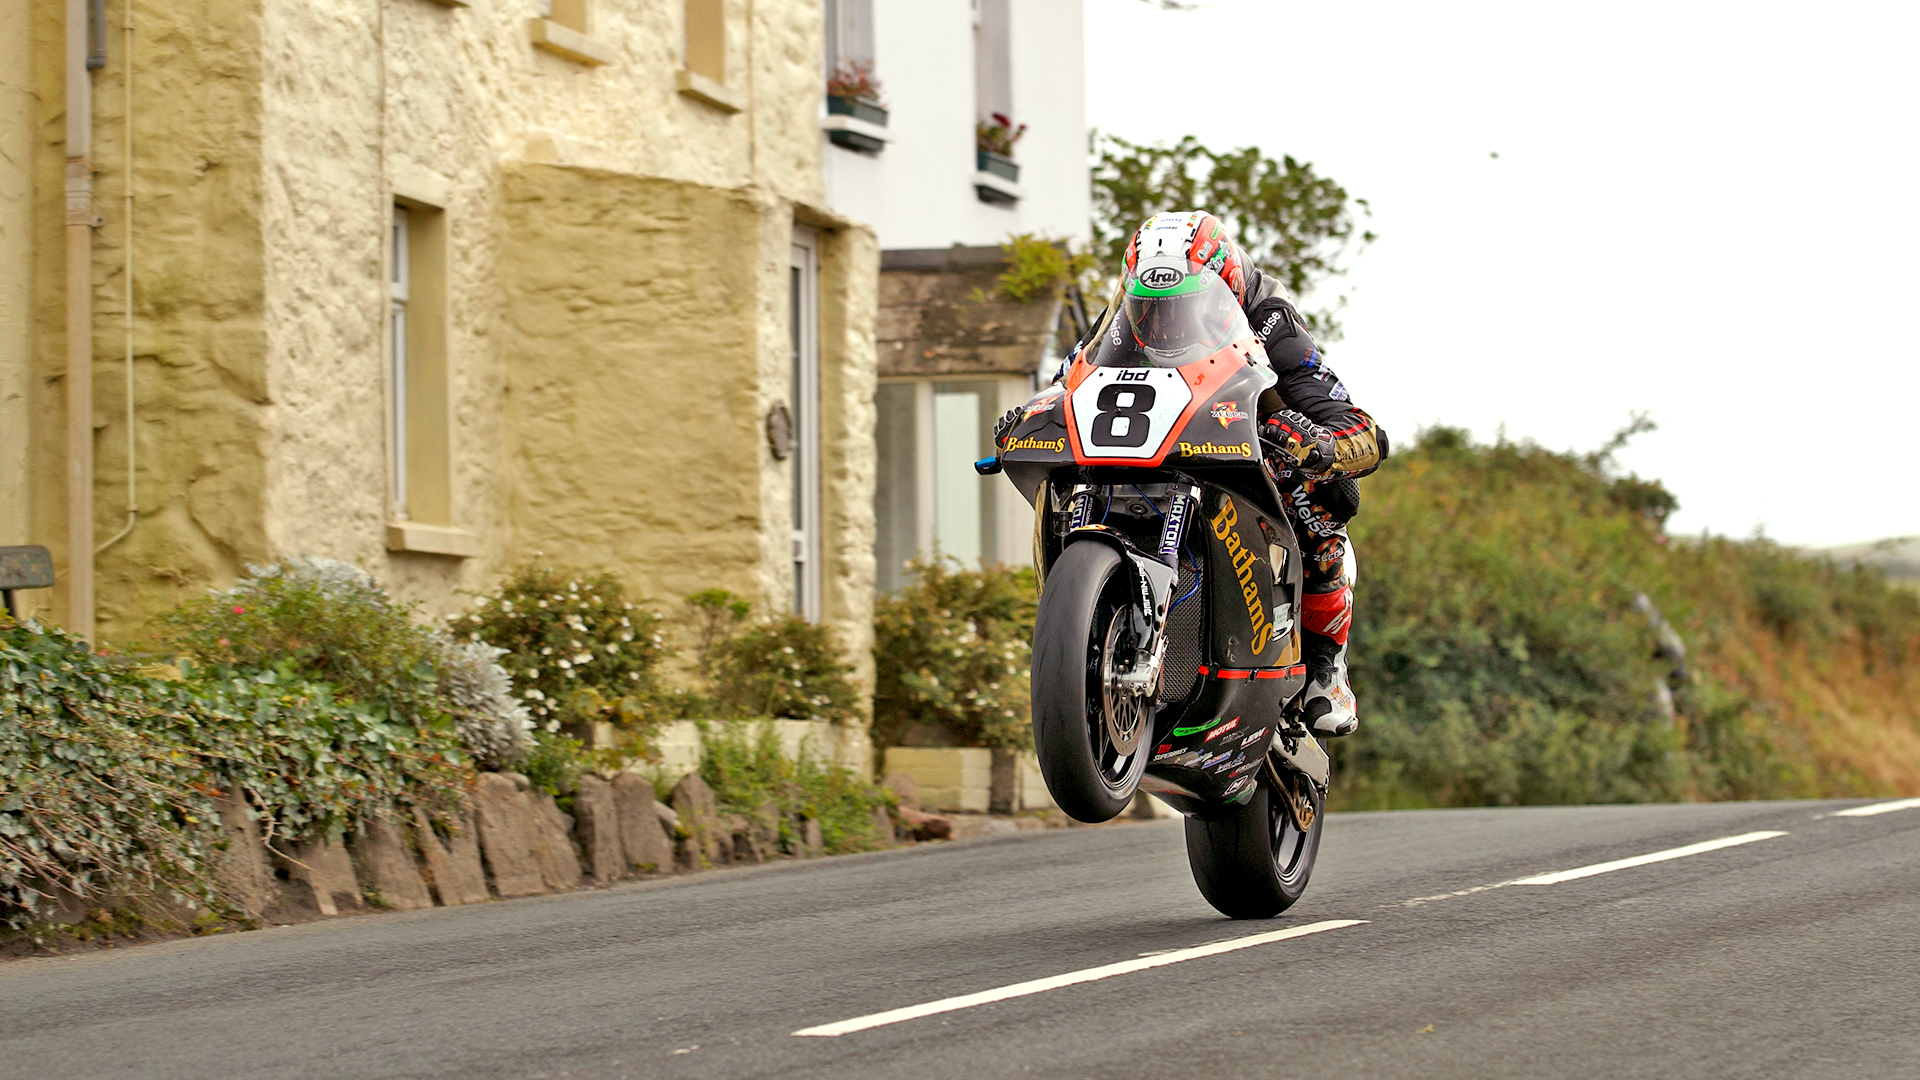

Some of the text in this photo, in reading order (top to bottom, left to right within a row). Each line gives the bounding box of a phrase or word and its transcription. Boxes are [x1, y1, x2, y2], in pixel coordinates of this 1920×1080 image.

[1143, 269, 1179, 283] Arai
[1116, 369, 1151, 382] ibd
[1090, 383, 1157, 448] 8
[1164, 495, 1185, 550] MAXTON
[1136, 560, 1153, 617] METZELER
[1206, 720, 1237, 741] MOTUL
